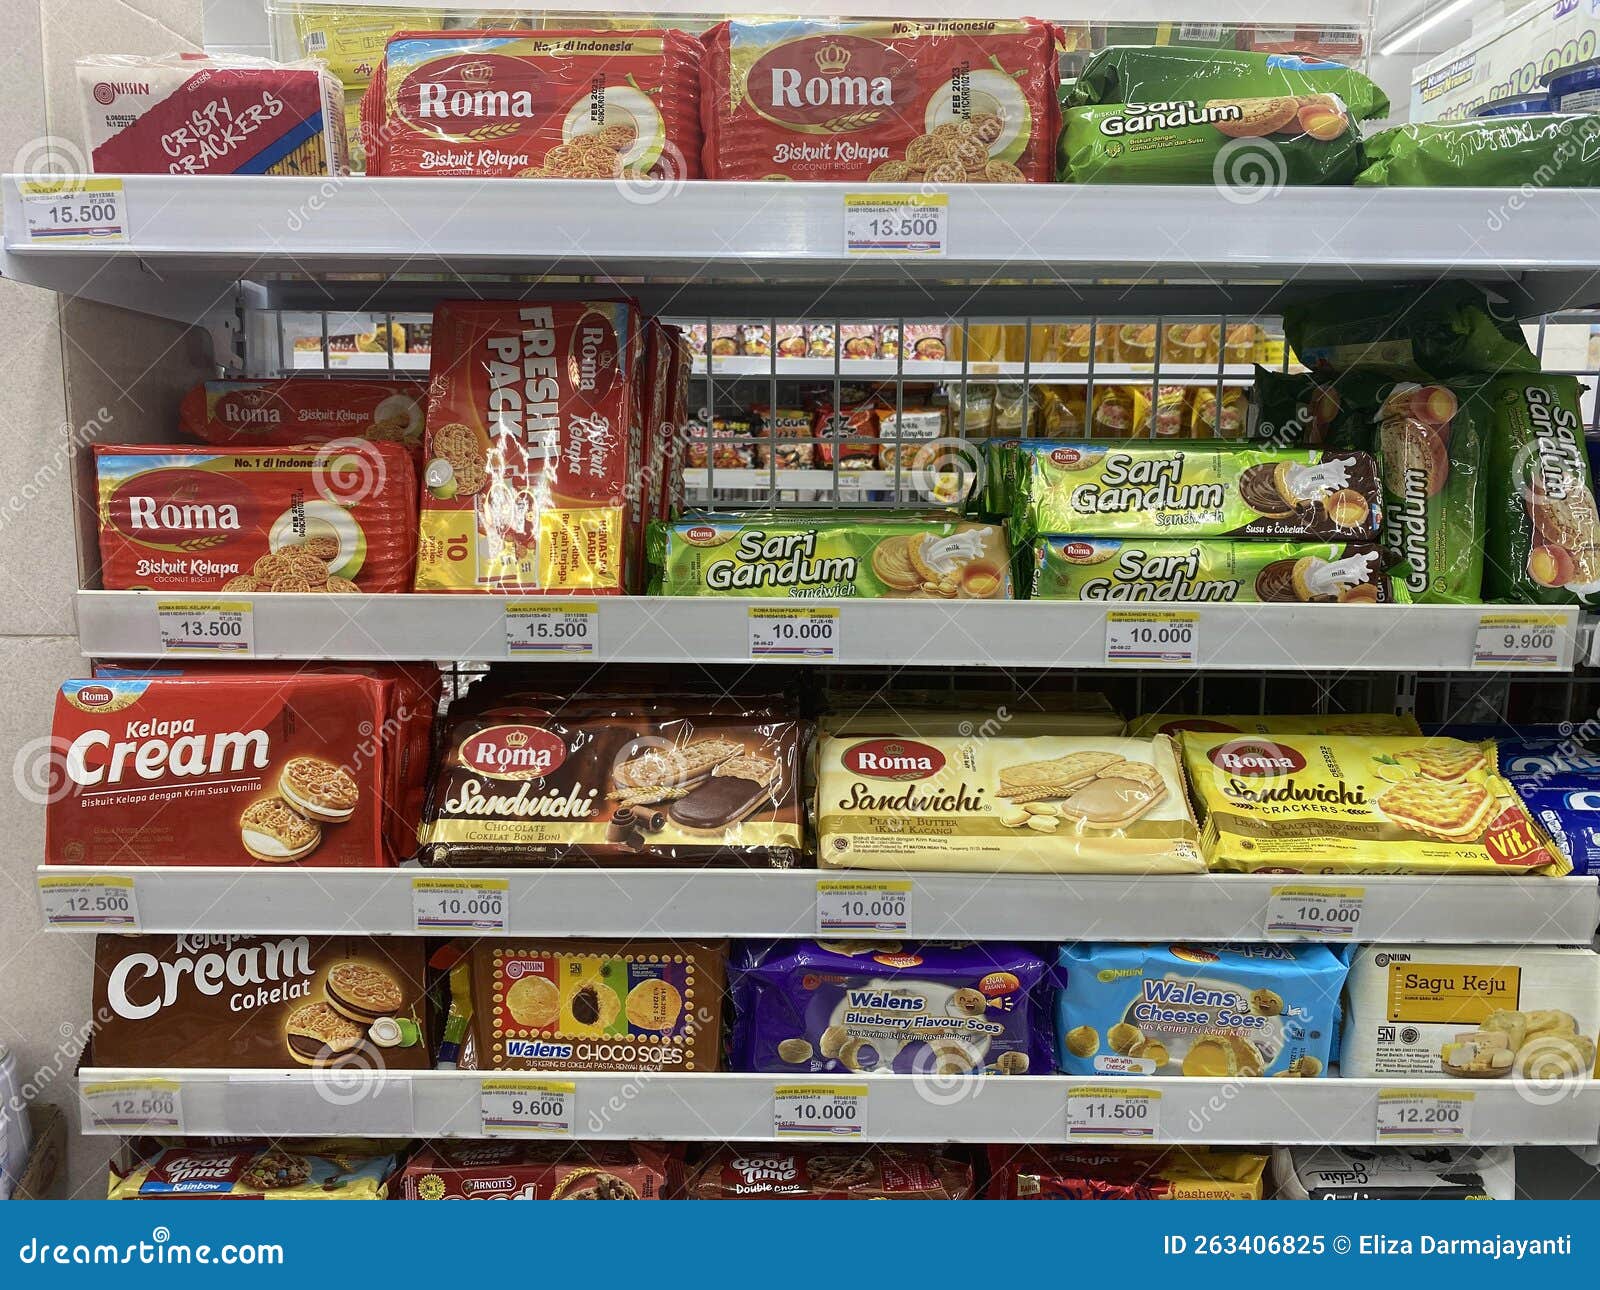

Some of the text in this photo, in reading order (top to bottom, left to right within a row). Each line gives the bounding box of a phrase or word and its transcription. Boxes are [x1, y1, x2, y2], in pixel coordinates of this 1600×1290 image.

[892, 22, 911, 34] No.
[772, 68, 895, 107] Roma
[952, 67, 961, 115] FEB 2023
[419, 83, 534, 119] Roma
[161, 97, 234, 158] CRISPY
[1100, 103, 1241, 136] Gandum
[419, 150, 529, 171] Biskuit Kelapa
[773, 143, 889, 163] Biskuit Kelapa
[792, 162, 864, 171] COCONUT BISCUIT
[50, 205, 116, 224] 15.500
[870, 219, 937, 236] 13.500
[582, 327, 604, 391] Roma
[488, 336, 523, 437] PACK
[225, 404, 281, 423] Roma
[299, 408, 369, 421] Biskuit Kelapa
[1525, 386, 1567, 500] Gandum
[234, 458, 329, 469] No. 1 di Indonesia
[1055, 452, 1078, 462] Roma
[1101, 453, 1183, 485] Sari
[1311, 474, 1325, 482] milk
[1071, 479, 1225, 513] Gandum
[129, 497, 241, 529] Roma
[1246, 524, 1264, 533] Susu
[1274, 523, 1304, 534] Cokelat
[1405, 469, 1427, 592] Gandum
[447, 534, 468, 561] 10
[737, 530, 815, 560] Sari
[1067, 545, 1092, 556] Roma
[136, 560, 239, 577] Biskuit Kelapa
[707, 551, 855, 590] Gandum
[1114, 549, 1198, 581] Sari
[1331, 569, 1346, 577] milk
[789, 585, 856, 598] Sandwich
[1080, 572, 1239, 600] Gandum
[181, 621, 241, 636] 13.500
[526, 623, 587, 638] 15.500
[772, 624, 832, 639] 10.000
[1131, 629, 1191, 643] 10.000
[1504, 635, 1553, 649] 9.900
[82, 691, 109, 702] Roma
[126, 719, 195, 740] Kelapa
[66, 730, 270, 786] Cream
[475, 743, 551, 767] Roma
[858, 752, 932, 771] Roma
[1222, 752, 1294, 768] Roma
[81, 783, 262, 807] Biskuit Kelapa dengan Krim Susu Vanilla
[446, 780, 594, 817] Sandwichi
[839, 783, 984, 811] Sandwichi
[1223, 780, 1367, 805] Sandwichi
[1262, 805, 1338, 814] CRACKERS
[484, 822, 545, 832] CHOCOLATE
[909, 826, 953, 835] KACANG)
[917, 818, 958, 827] BUTTER
[465, 832, 560, 841] (COKELAT BON BON)
[66, 898, 129, 912] 12.500
[438, 900, 502, 915] 10.000
[842, 902, 905, 916] 10.000
[1297, 907, 1361, 923] 10.000
[107, 935, 316, 1020] Cream
[986, 976, 1004, 985] ENAK
[1405, 974, 1506, 995] Sagu Keju
[230, 979, 311, 1012] Cokelat
[850, 992, 924, 1010] Walens
[1143, 980, 1238, 1008] Walens
[845, 1013, 1000, 1033] Blueberry Flavour Soes
[1135, 1004, 1265, 1028] Cheese Soes
[507, 1041, 683, 1064] Walens CHOCO SOES
[112, 1101, 174, 1114] 12.500
[512, 1102, 563, 1116] 9.600
[795, 1104, 856, 1119] 10.000
[1086, 1104, 1147, 1119] 11.500
[1398, 1108, 1460, 1123] 12.200
[166, 1156, 237, 1171] Good
[732, 1157, 793, 1171] Good
[172, 1168, 233, 1182] Time
[743, 1168, 796, 1183] Time
[172, 1182, 221, 1192] Rainbow
[736, 1183, 772, 1194] Double
[1178, 1189, 1222, 1200] cashew
